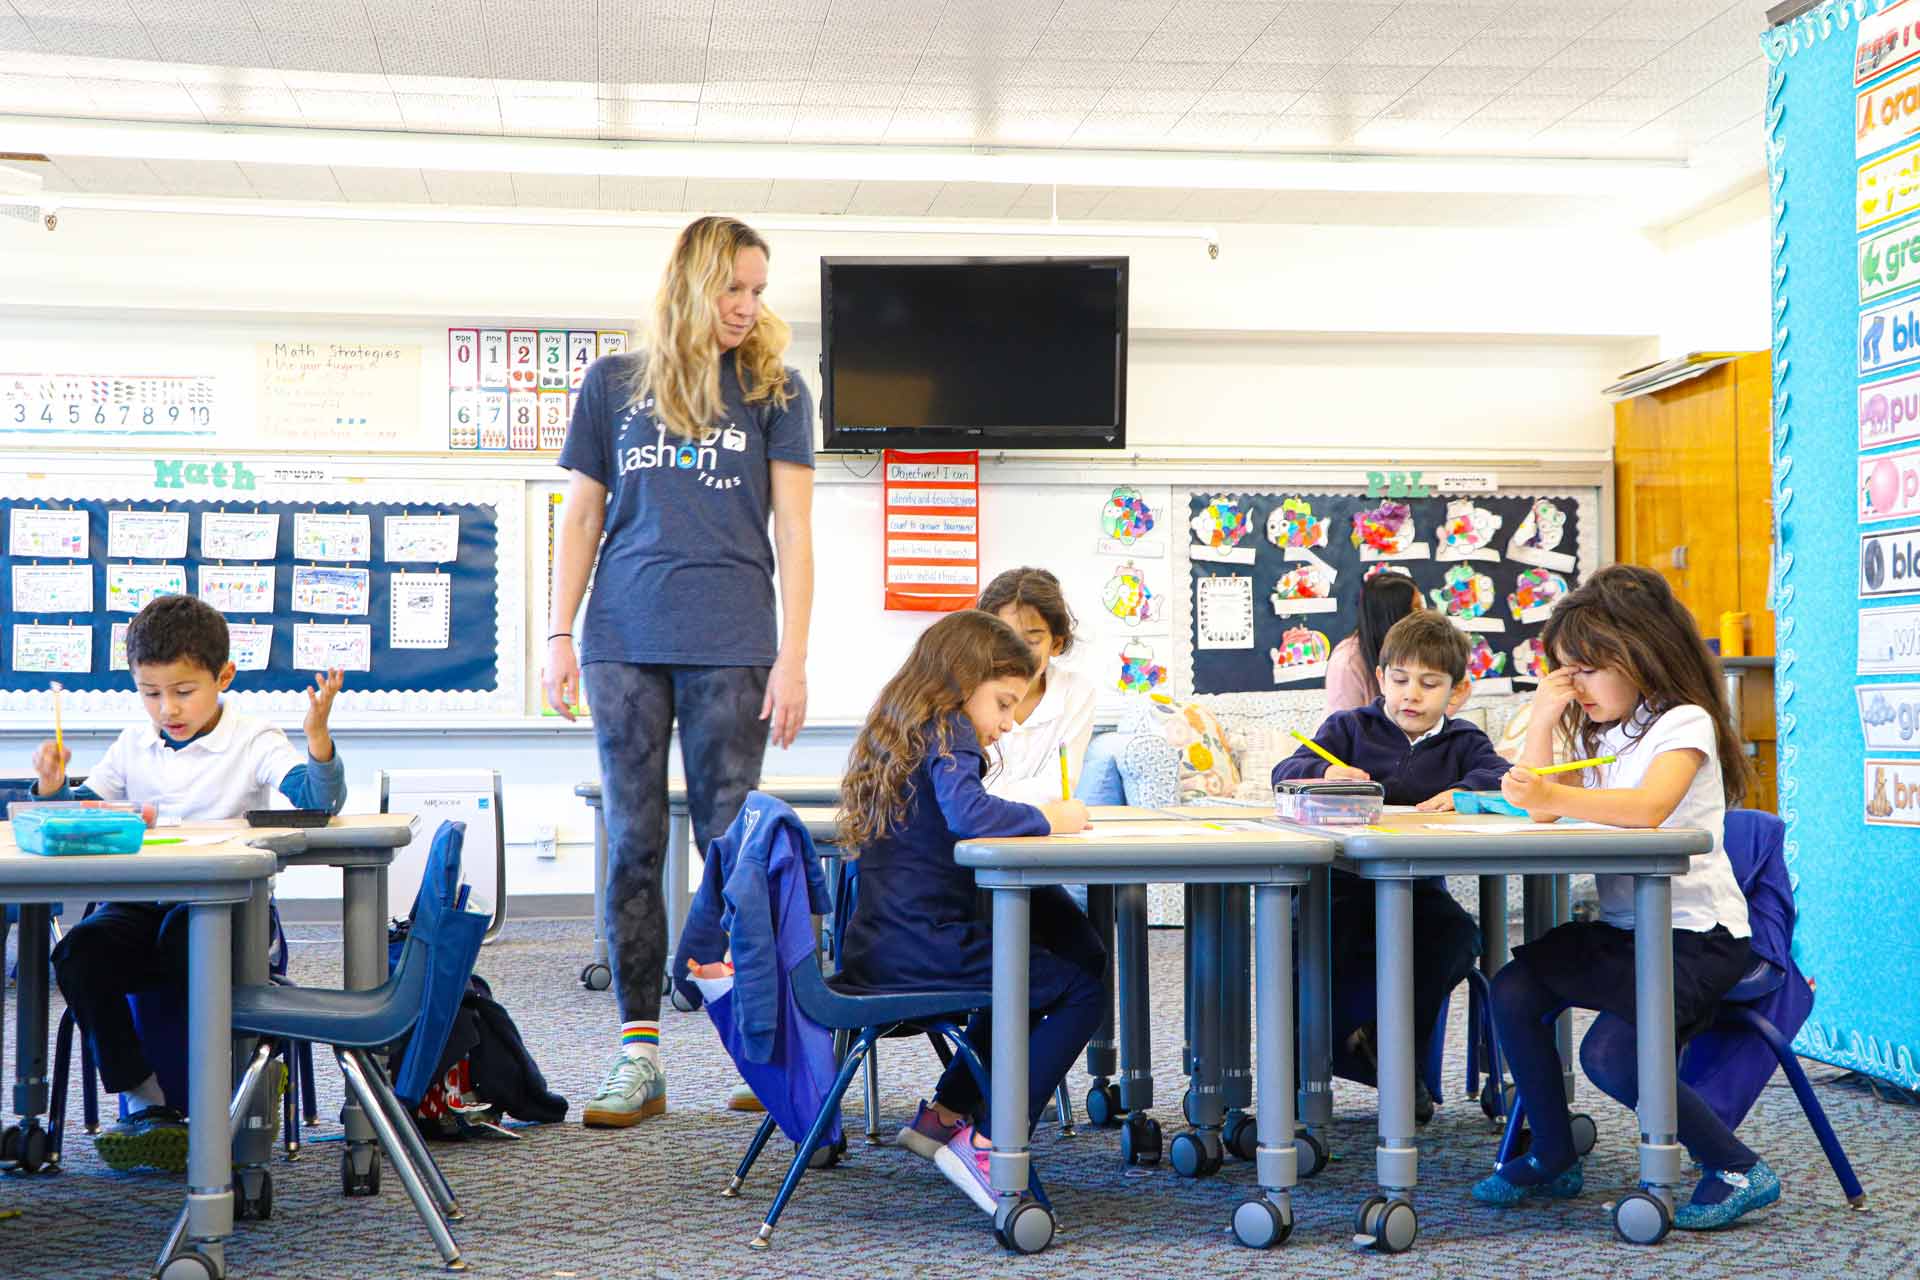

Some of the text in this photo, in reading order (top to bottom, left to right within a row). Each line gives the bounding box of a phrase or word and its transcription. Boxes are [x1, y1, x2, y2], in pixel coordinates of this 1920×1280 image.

[274, 343, 315, 358] Math
[458, 344, 470, 363] 0
[489, 345, 498, 363] 1
[518, 345, 530, 364] 2
[547, 346, 559, 364] 3
[576, 347, 588, 365] 4
[14, 403, 210, 426] 3 4 5 6 7 8 9 10
[457, 406, 470, 424] 6
[488, 407, 501, 423] 7
[517, 406, 530, 424] 8
[154, 459, 257, 491] Math
[697, 471, 742, 490] YEARS
[1366, 471, 1430, 498] PBL
[1894, 772, 1920, 809] br
